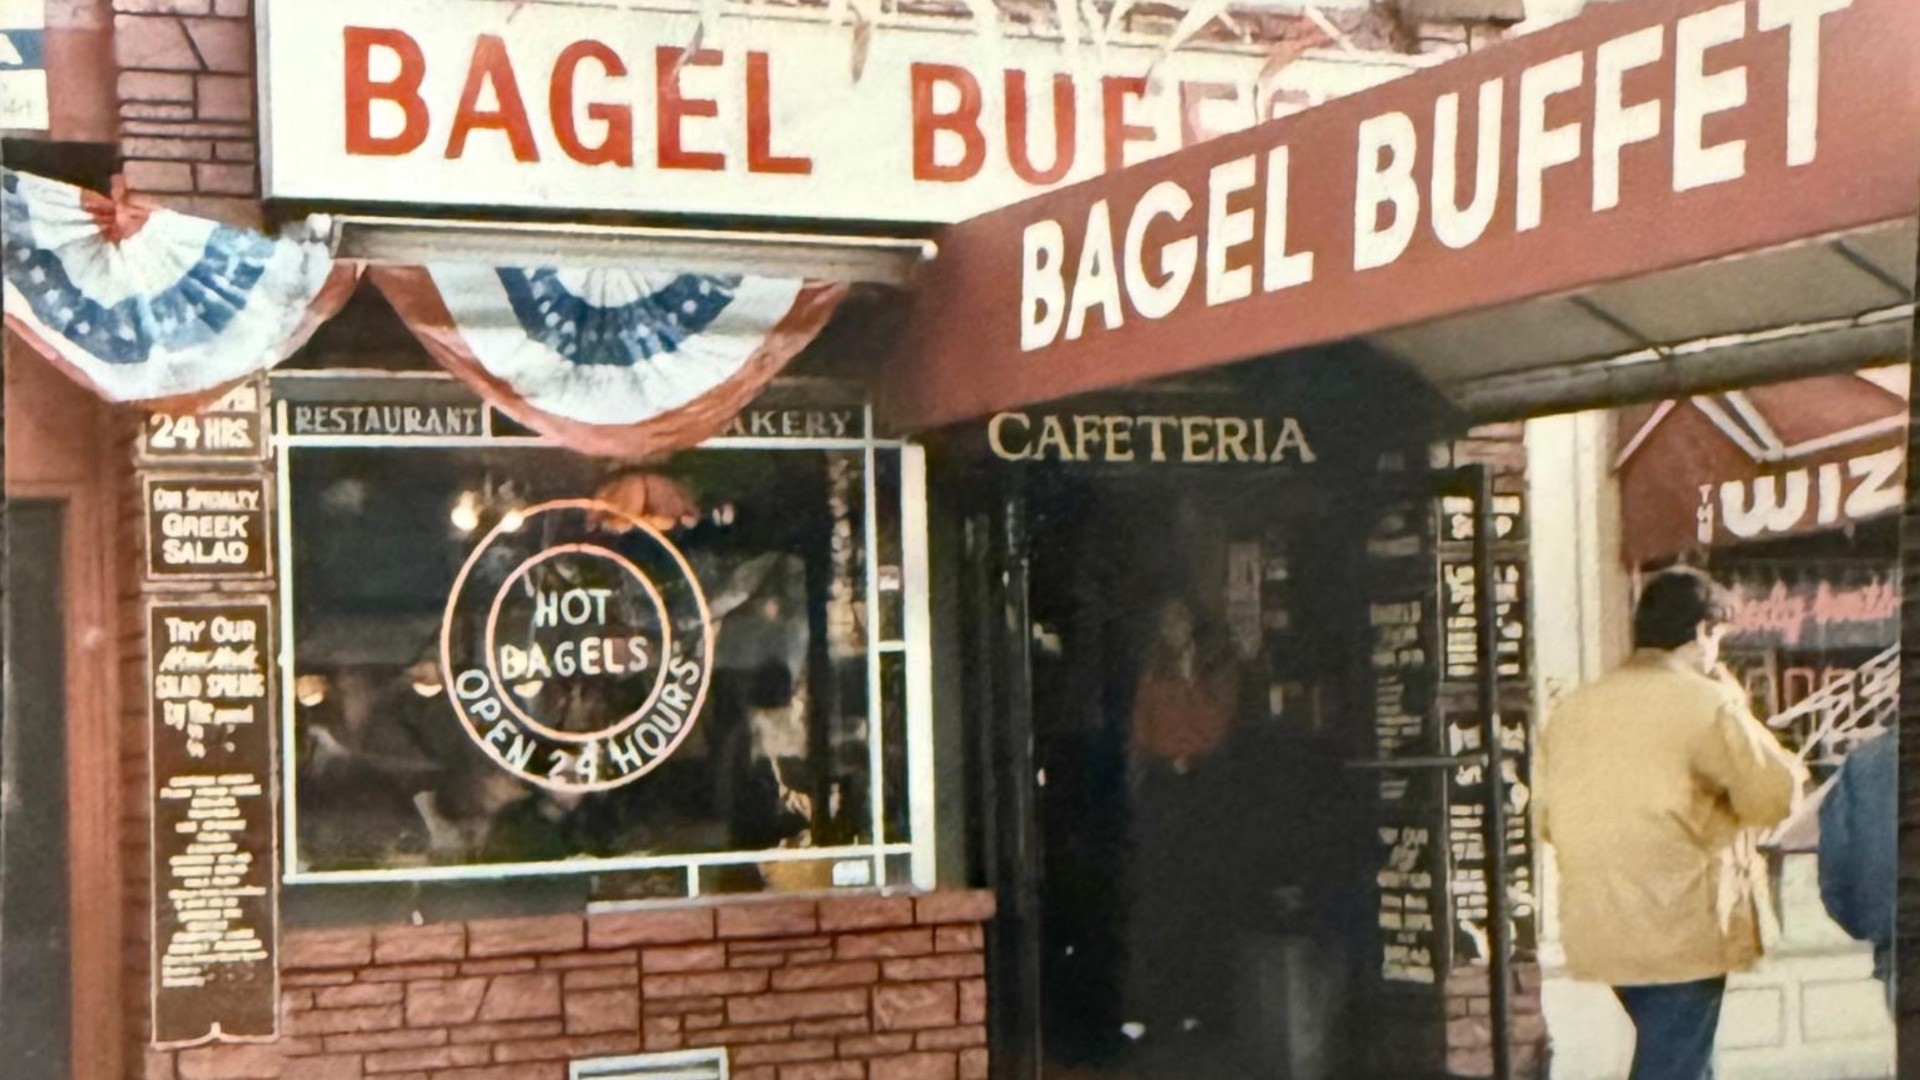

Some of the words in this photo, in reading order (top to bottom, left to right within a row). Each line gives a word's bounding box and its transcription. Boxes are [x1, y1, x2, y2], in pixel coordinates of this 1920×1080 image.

[343, 26, 812, 175] BAGEL
[911, 62, 1338, 184] BUFF
[1021, 145, 1313, 352] BAGEL
[1354, 0, 1854, 271] BUFFET
[151, 413, 200, 449] 24
[295, 406, 477, 433] RESTAURANT
[722, 410, 851, 436] AKERY
[988, 412, 1317, 462] CAFETERIA
[1720, 446, 1905, 538] WIZ
[162, 512, 249, 538] GREEK
[163, 539, 249, 564] SALAD
[536, 588, 612, 627] HOT
[500, 636, 648, 680] BAGELS
[456, 669, 537, 771] OPEN
[548, 740, 598, 784] 24
[608, 657, 700, 774] HOURS
